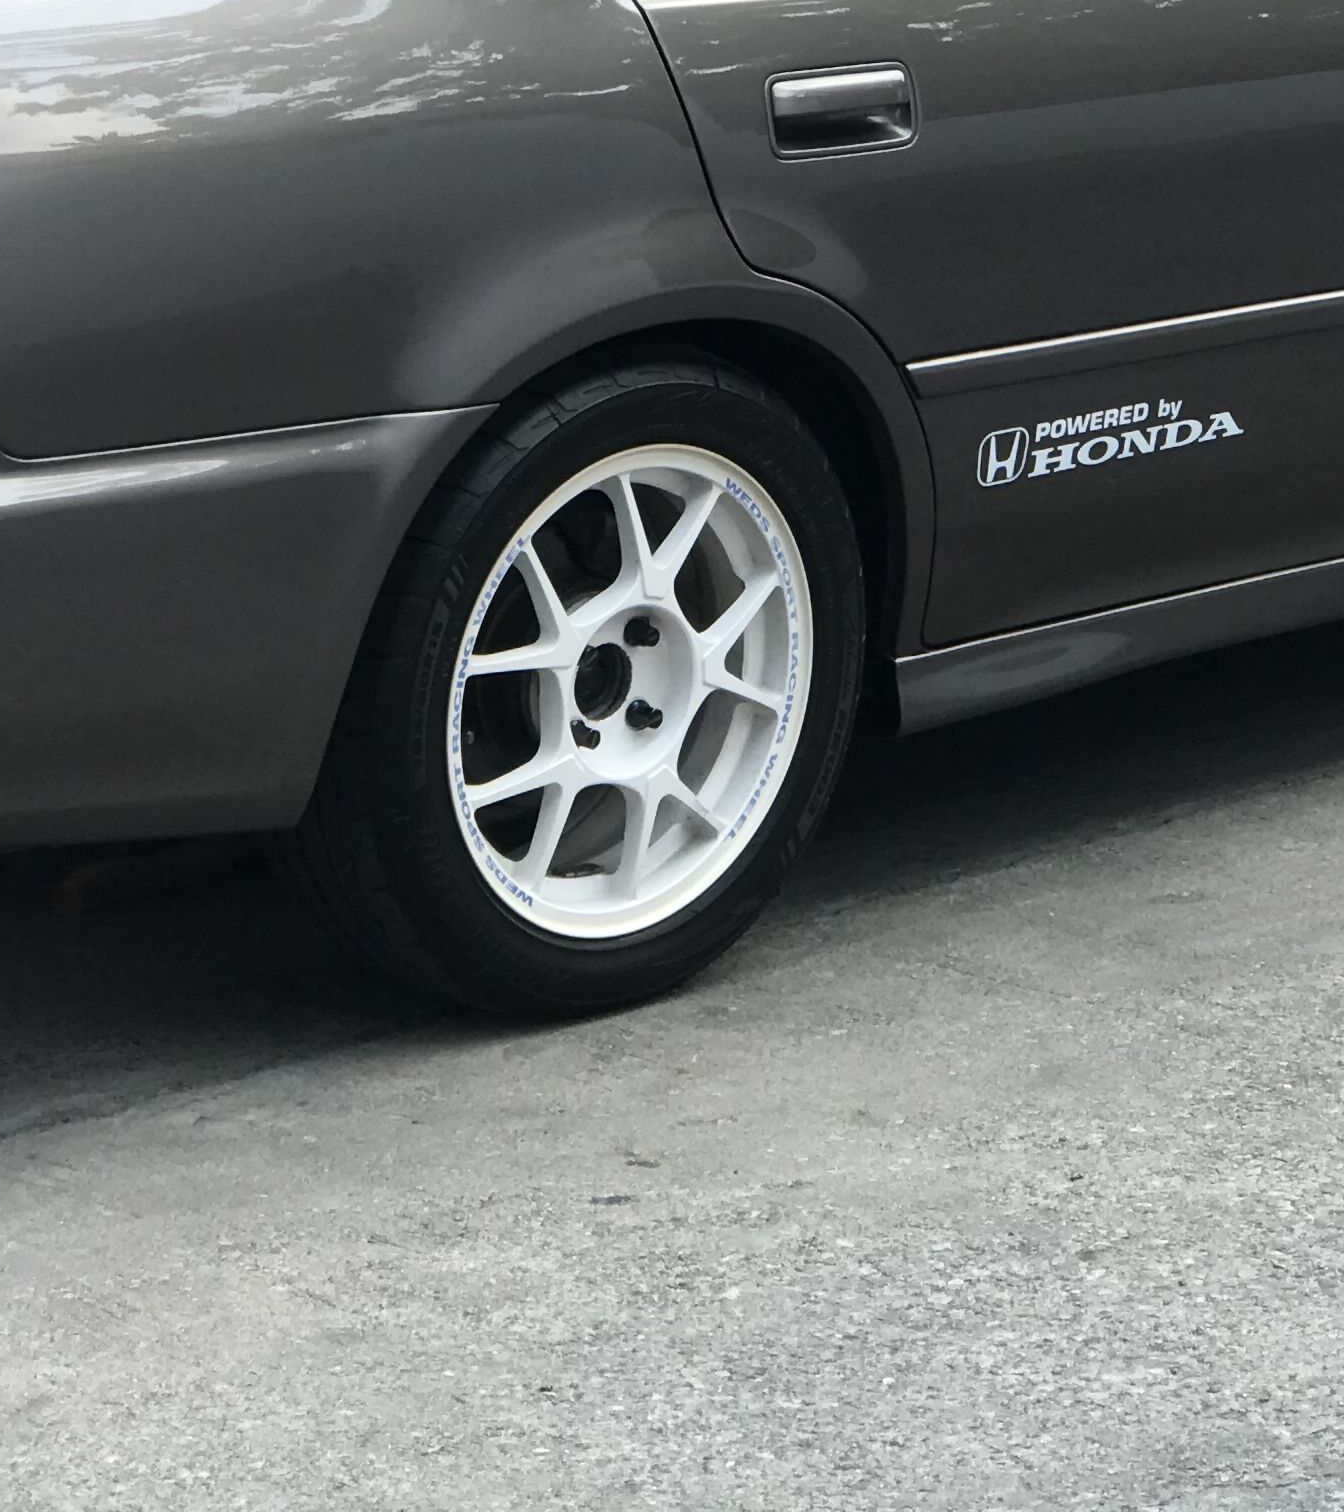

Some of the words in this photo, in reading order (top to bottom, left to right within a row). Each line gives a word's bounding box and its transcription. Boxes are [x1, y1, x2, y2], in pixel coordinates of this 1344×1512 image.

[1027, 411, 1244, 478] HONDA
[1035, 402, 1149, 442] POWERED
[1157, 398, 1183, 420] by
[776, 632, 799, 744] RACING
[485, 854, 534, 908] WEDS
